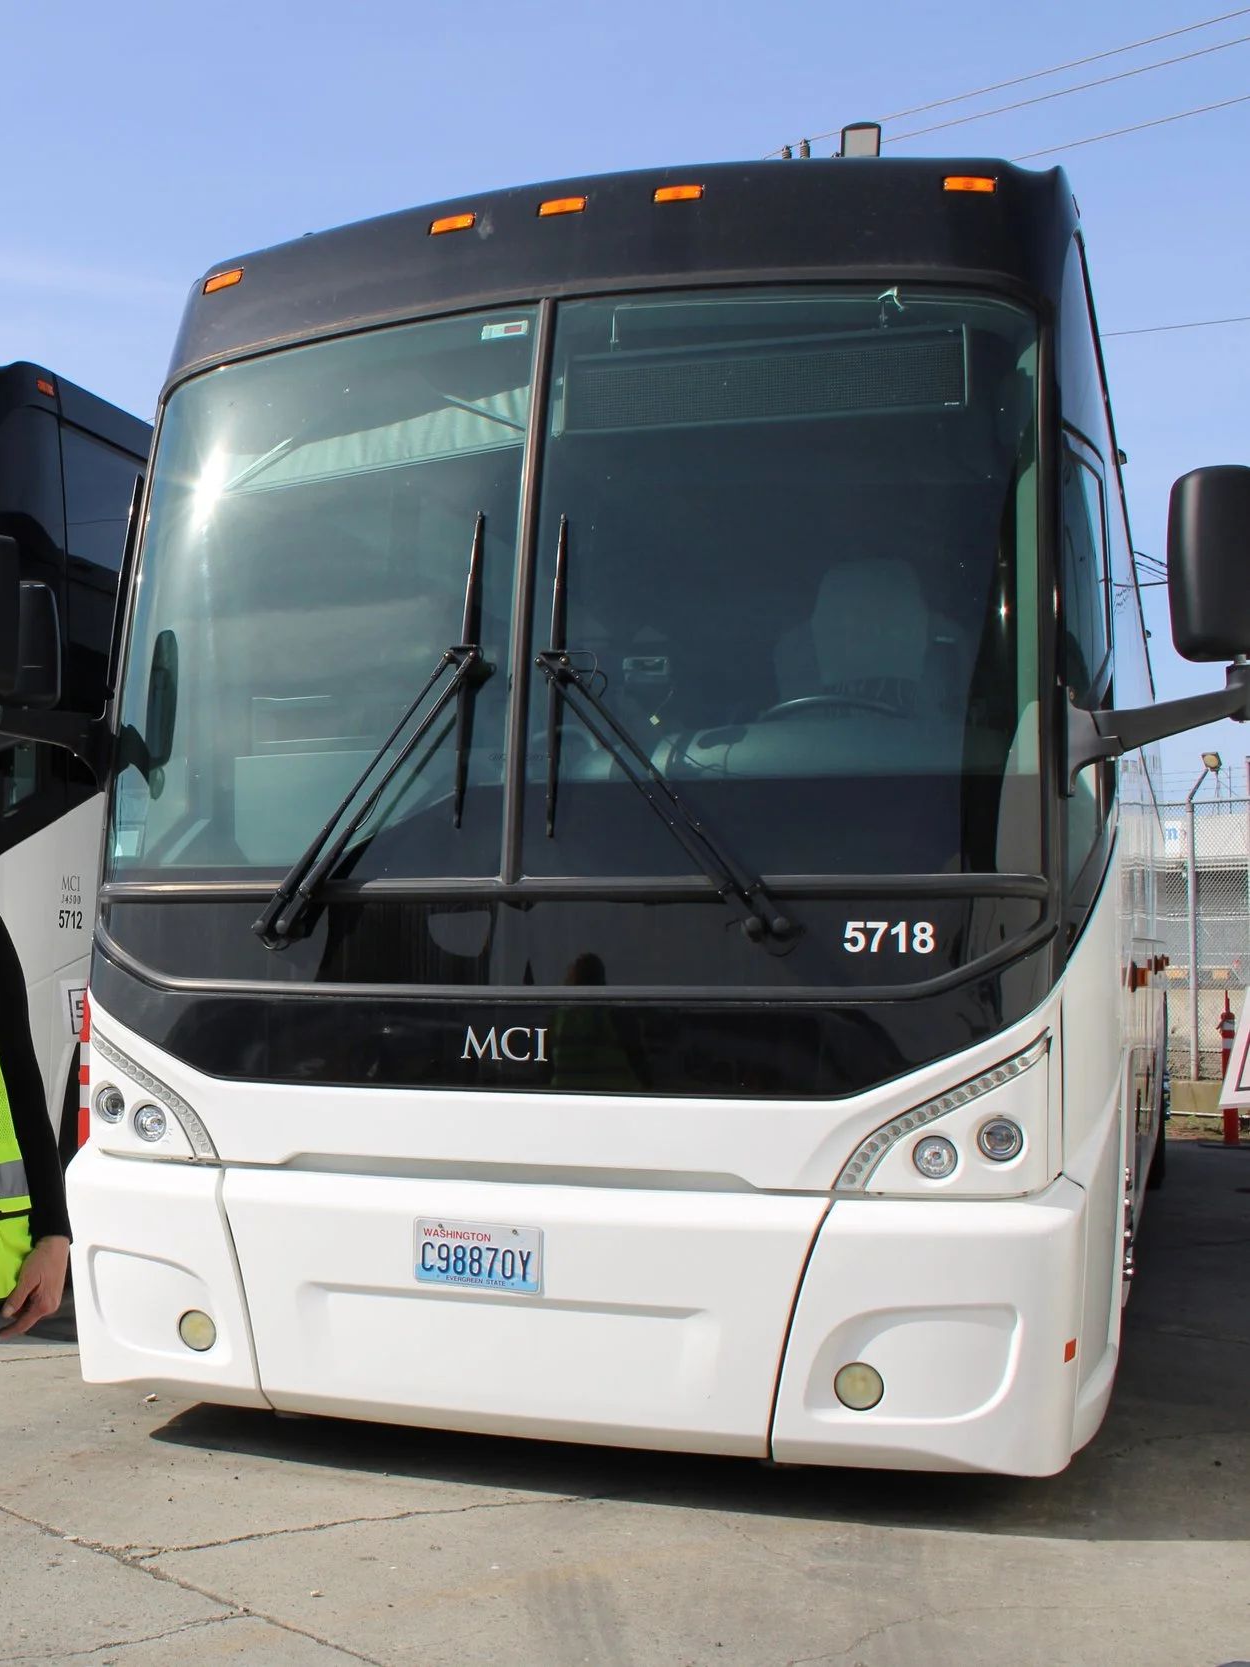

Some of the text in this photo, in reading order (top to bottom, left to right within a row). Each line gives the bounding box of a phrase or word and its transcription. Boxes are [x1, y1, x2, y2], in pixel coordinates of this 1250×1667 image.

[61, 875, 80, 891] MCI
[58, 910, 82, 929] 5712
[843, 921, 935, 954] 5718
[460, 1025, 548, 1061] MCI
[423, 1227, 491, 1242] WASHINGTON
[421, 1241, 531, 1282] C98870Y
[445, 1275, 483, 1284] EVERGREEN
